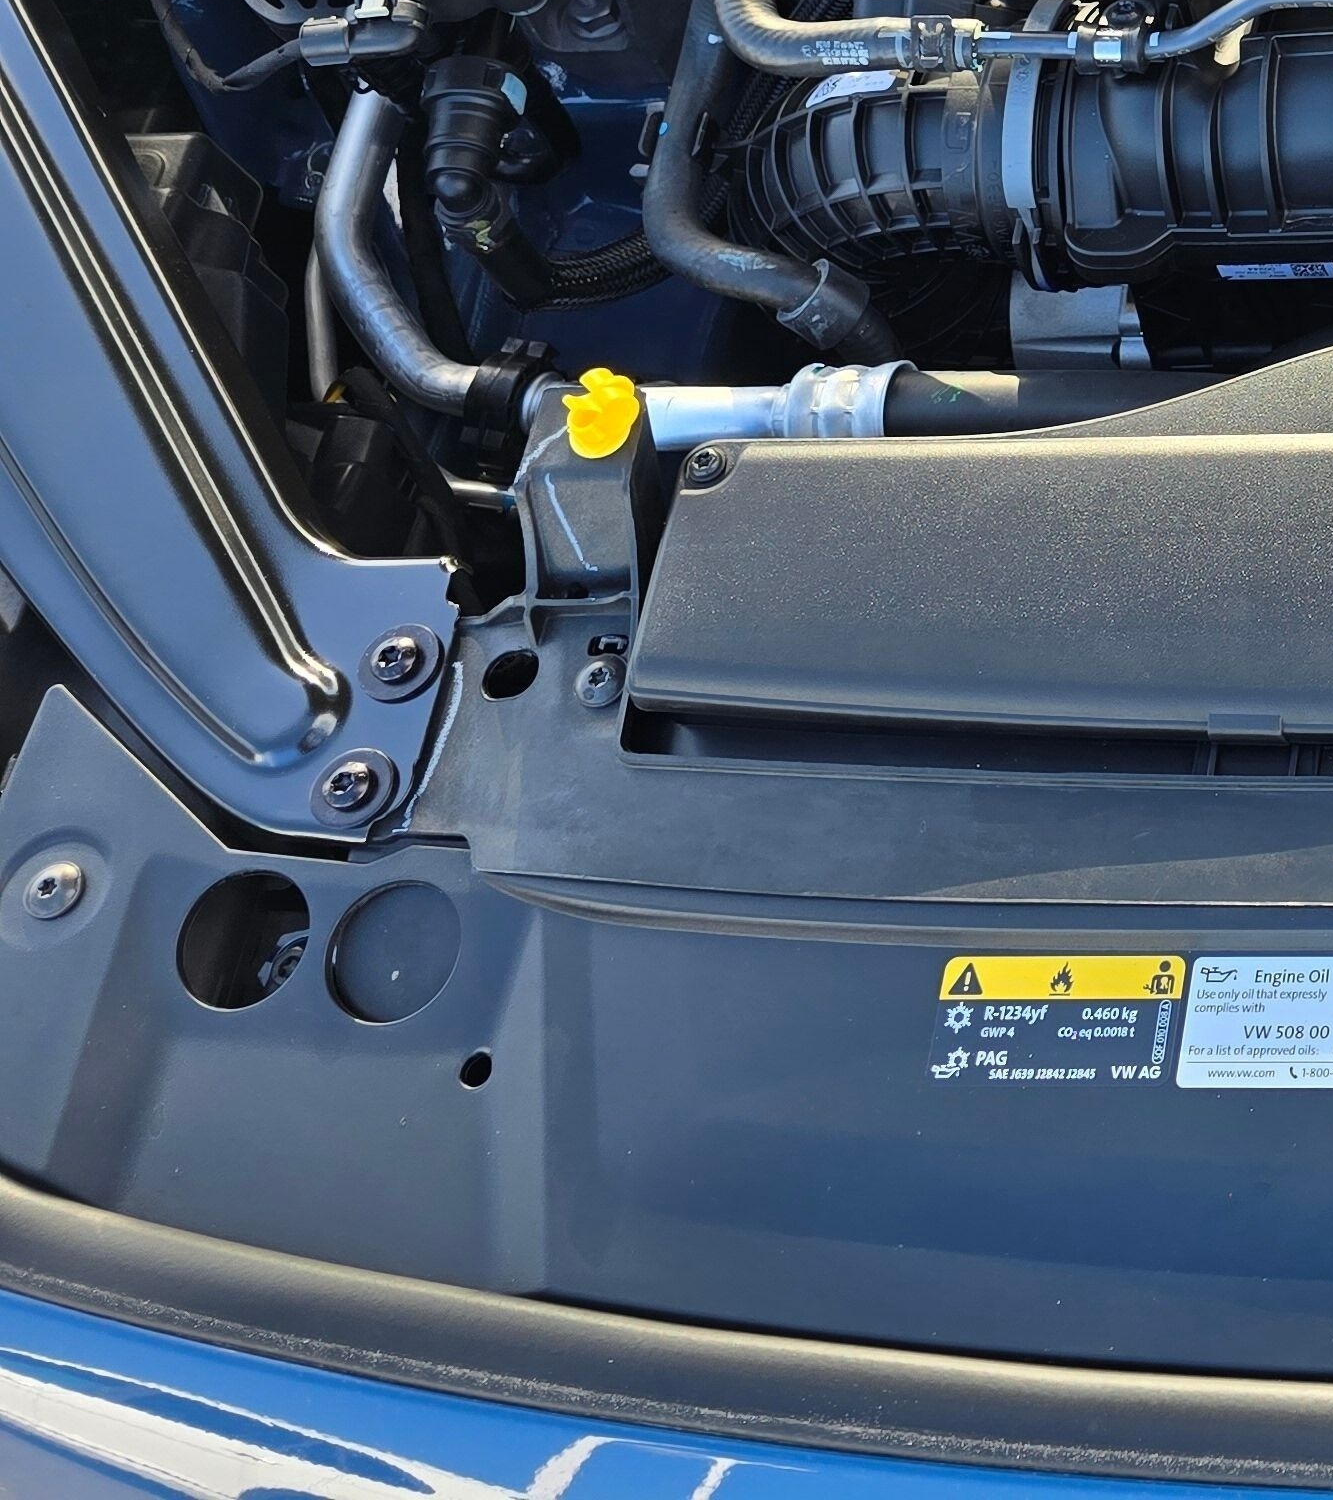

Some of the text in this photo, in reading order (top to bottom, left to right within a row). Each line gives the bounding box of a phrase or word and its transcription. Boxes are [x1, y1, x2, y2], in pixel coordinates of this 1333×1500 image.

[1254, 968, 1330, 988] Engine Oil
[1196, 988, 1328, 1003] Use only oil that expressly
[983, 1004, 1049, 1025] R-1234yf
[1081, 1006, 1139, 1024] 0.460 kg
[1194, 1002, 1266, 1016] complies with
[980, 1026, 1015, 1038] GWP 4
[1078, 1028, 1093, 1041] eq
[1093, 1026, 1129, 1038] 0.0018
[1129, 1026, 1136, 1038] t
[1243, 1025, 1273, 1039] VW
[1275, 1025, 1305, 1040] 508
[1309, 1025, 1330, 1040] 00
[975, 1050, 1008, 1066] PAG
[1188, 1044, 1319, 1059] For a list of approved oils:
[988, 1068, 1097, 1080] SAE J639 J2842 J2845
[1111, 1065, 1162, 1080] VW AG
[1207, 1070, 1276, 1078] www.vw.com
